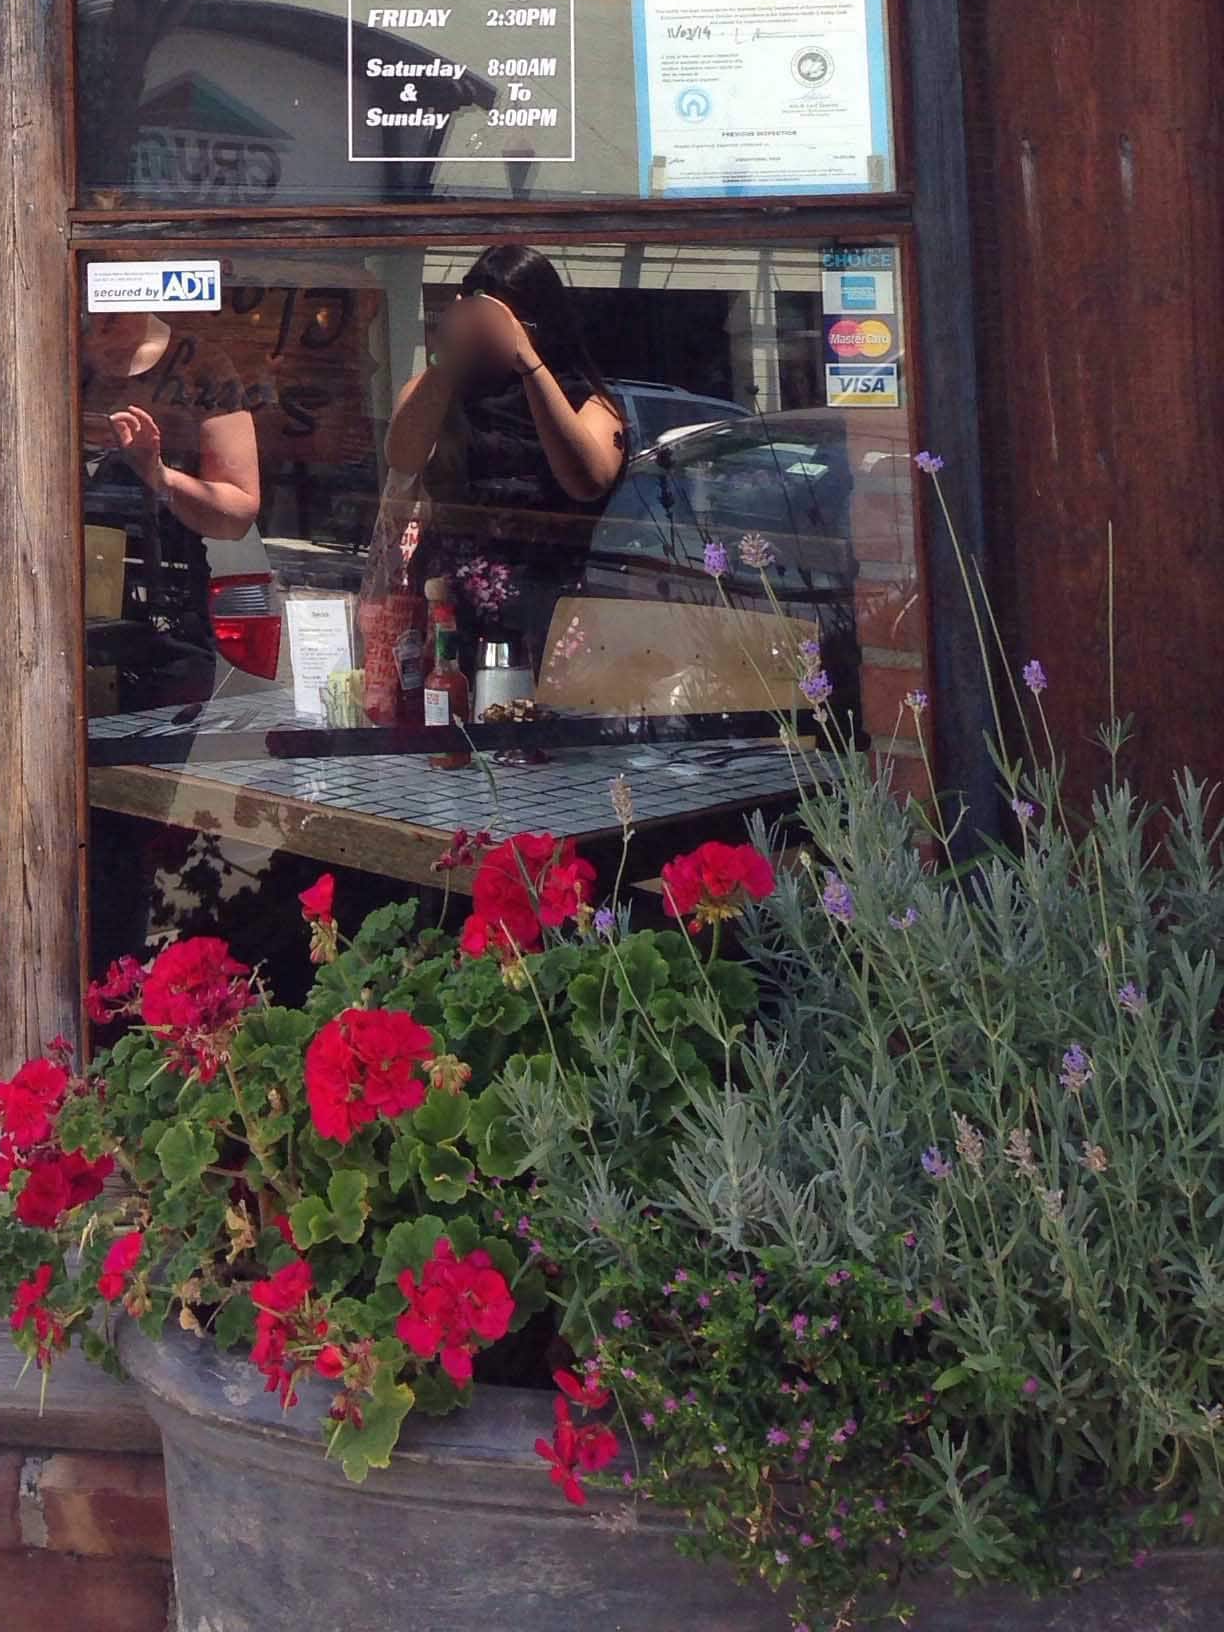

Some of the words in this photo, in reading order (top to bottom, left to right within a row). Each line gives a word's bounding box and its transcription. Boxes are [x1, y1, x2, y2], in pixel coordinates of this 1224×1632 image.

[367, 9, 452, 28] FRIDAY
[486, 8, 557, 27] 2:30PM
[366, 58, 467, 80] Saturday
[488, 58, 557, 76] 8:00AM
[399, 83, 418, 102] &
[508, 83, 532, 101] To
[366, 107, 450, 130] Sunday
[488, 108, 558, 127] 3:00PM
[93, 287, 142, 298] secured
[145, 286, 161, 299] by
[164, 271, 213, 299] ADT
[831, 333, 890, 345] MasterCard
[839, 377, 886, 393] VISA
